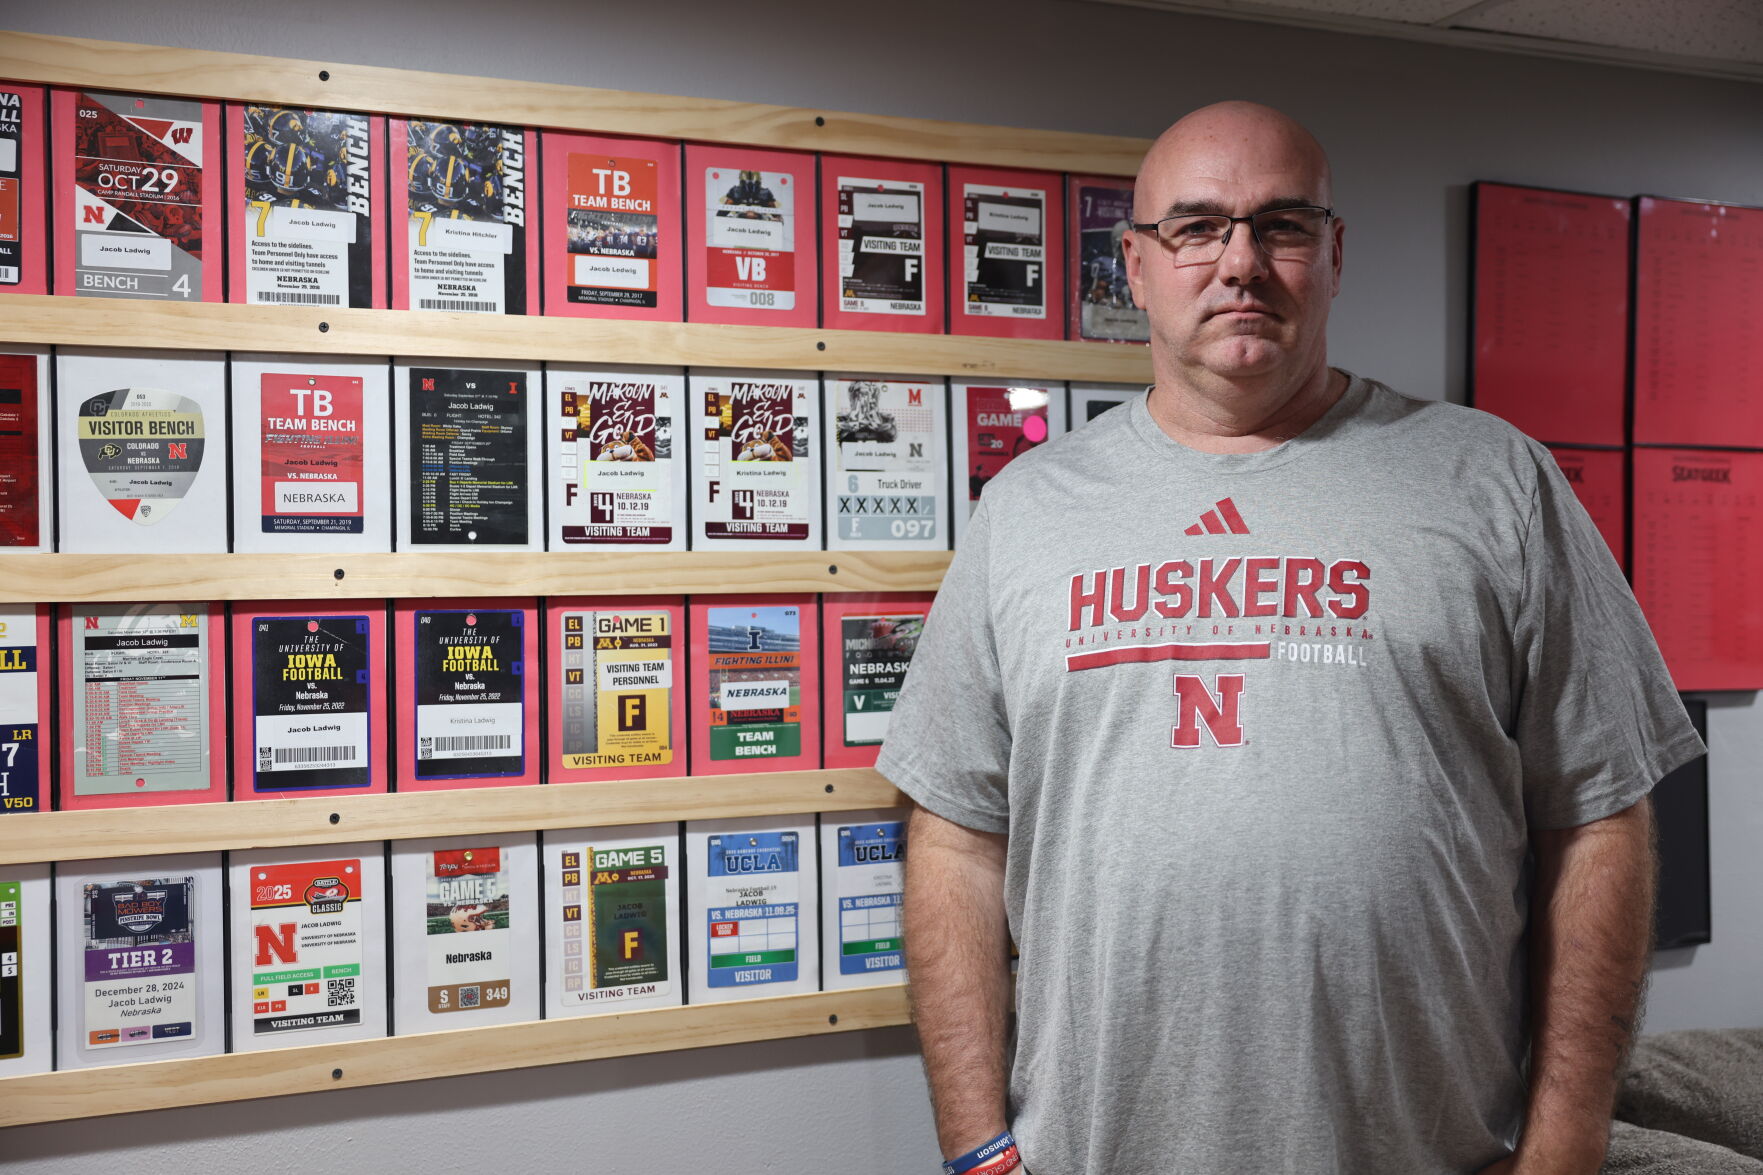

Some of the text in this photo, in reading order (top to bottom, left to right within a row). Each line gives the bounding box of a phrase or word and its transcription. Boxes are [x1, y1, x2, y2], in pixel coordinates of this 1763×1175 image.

[80, 110, 97, 118] 025
[171, 128, 193, 144] W
[99, 164, 141, 174] SATURDAY
[346, 117, 369, 217] BENCH
[98, 168, 178, 192] OCT 29
[503, 129, 524, 227] BENCH
[592, 168, 630, 196] TB
[573, 194, 650, 211] TEAM BENCH
[84, 205, 104, 224] N
[251, 200, 272, 237] 7
[312, 221, 336, 229] Ladwig
[414, 211, 432, 246] 7
[124, 247, 150, 255] Ladwig
[864, 240, 920, 252] VISITING TEAM
[988, 244, 1042, 258] VISITING TEAM
[736, 256, 766, 281] VB
[905, 258, 918, 282] F
[1026, 264, 1039, 287] F
[84, 274, 191, 297] BENCH 4
[750, 292, 774, 306] 008
[290, 389, 333, 417] TB
[448, 402, 494, 411] Jacob Ladwig
[268, 418, 356, 431] TEAM BENCH
[977, 413, 1022, 427] GAME
[89, 420, 195, 436] VISITOR BENCH
[168, 443, 187, 459] N
[909, 443, 923, 457] N
[848, 474, 859, 493] 6
[878, 479, 922, 489] Truck Driver
[283, 493, 346, 503] NEBRASKA
[566, 484, 577, 506] F
[709, 481, 720, 503] F
[617, 502, 648, 510] 10.12.19
[757, 499, 787, 508] 10.12.19
[584, 526, 650, 536] VISITING TEAM
[726, 522, 788, 533] VISITING TEAM
[1068, 555, 1371, 632] HUSKERS
[85, 616, 99, 629] N
[180, 615, 198, 628] M
[568, 617, 665, 633] EL GAME 1
[463, 628, 477, 636] THE
[1065, 623, 1369, 649] UNIVERSITY OF NEBRASKA
[116, 638, 168, 647] Jacob Ladwig
[304, 636, 319, 644] THE
[439, 636, 487, 644] UNIVERSITY
[568, 636, 580, 647] PB
[748, 630, 762, 650] I
[279, 643, 344, 653] UNIVERSITY OF
[448, 646, 493, 659] IOWA
[1277, 640, 1368, 667] FOOTBALL
[287, 654, 336, 668] IOWA
[443, 659, 500, 672] FOOTBALL
[715, 655, 794, 665] FIGHTING ILLINI
[282, 668, 343, 681] FOOTBALL
[607, 663, 664, 674] VISITING TEAM
[849, 662, 910, 675] NEBRASK
[568, 672, 581, 682] VT
[613, 675, 659, 686] PERSONNEL
[454, 682, 485, 690] Nebraska
[296, 691, 328, 700] Nebraska
[727, 688, 787, 698] NEBRASKA
[853, 695, 865, 710] V
[625, 698, 640, 727] F
[1170, 673, 1246, 749] N
[13, 730, 32, 740] LR
[288, 724, 341, 734] Jacob Ladwig
[737, 731, 774, 742] TEAM
[735, 745, 776, 756] BENCH
[573, 753, 662, 766] VISITING TEAM
[4, 797, 33, 809] V50
[565, 856, 576, 866] EL
[596, 849, 662, 868] GAME 5
[725, 853, 781, 873] UCLA
[565, 873, 577, 884] PB
[257, 885, 292, 901] 2025
[118, 906, 162, 915] MOWERS
[312, 902, 342, 912] CLASSIC
[566, 908, 578, 919] VT
[254, 922, 298, 967] N
[624, 931, 638, 959] F
[108, 949, 173, 969] TIER 2
[446, 951, 492, 964] Nebraska
[865, 955, 900, 968] VISITOR
[735, 969, 772, 982] VISITOR
[95, 981, 184, 997] December 28, 2024
[578, 985, 655, 1001] VISITING TEAM
[108, 996, 172, 1008] Jacob Ladwig
[440, 990, 448, 1003] S
[120, 1007, 162, 1018] Nebraska
[271, 1014, 344, 1028] VISITING TEAM
[976, 1135, 1009, 1159] Johnson
